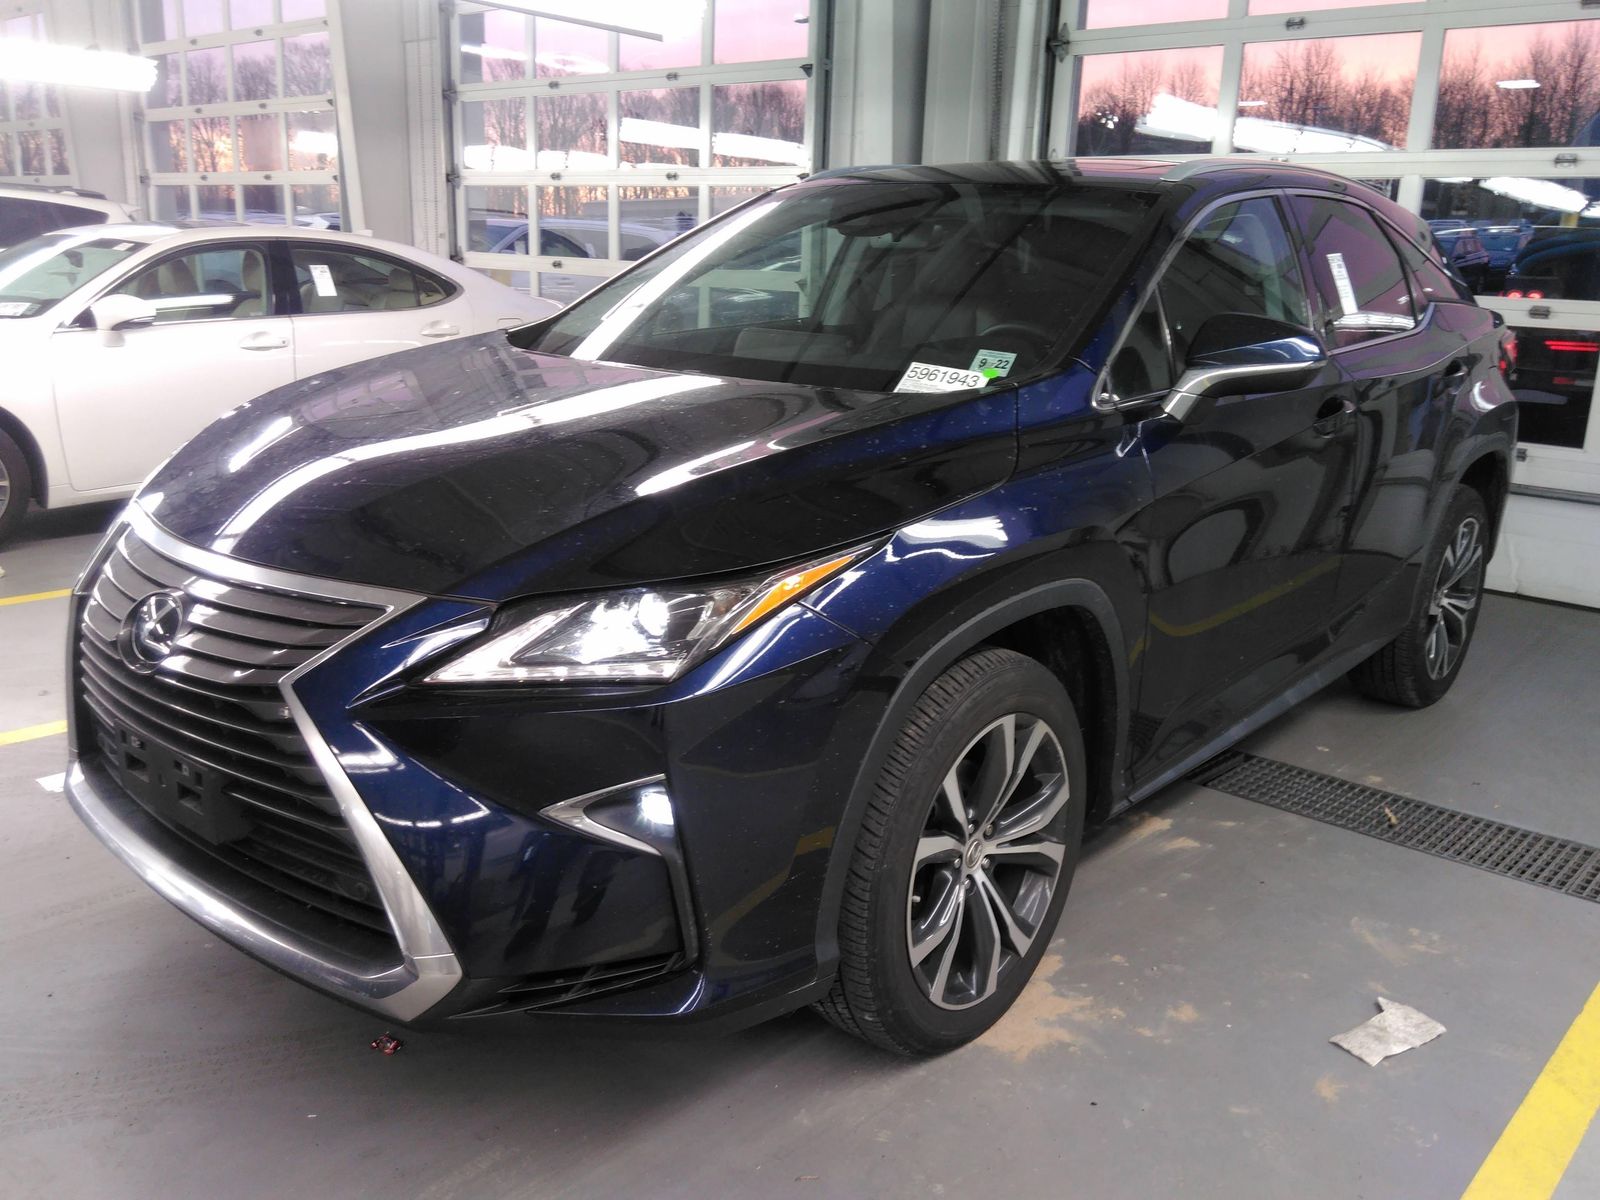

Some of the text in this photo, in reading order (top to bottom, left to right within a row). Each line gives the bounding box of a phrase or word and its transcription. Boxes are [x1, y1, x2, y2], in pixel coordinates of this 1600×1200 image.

[979, 358, 1010, 369] 9 22
[907, 366, 980, 388] 5961943
